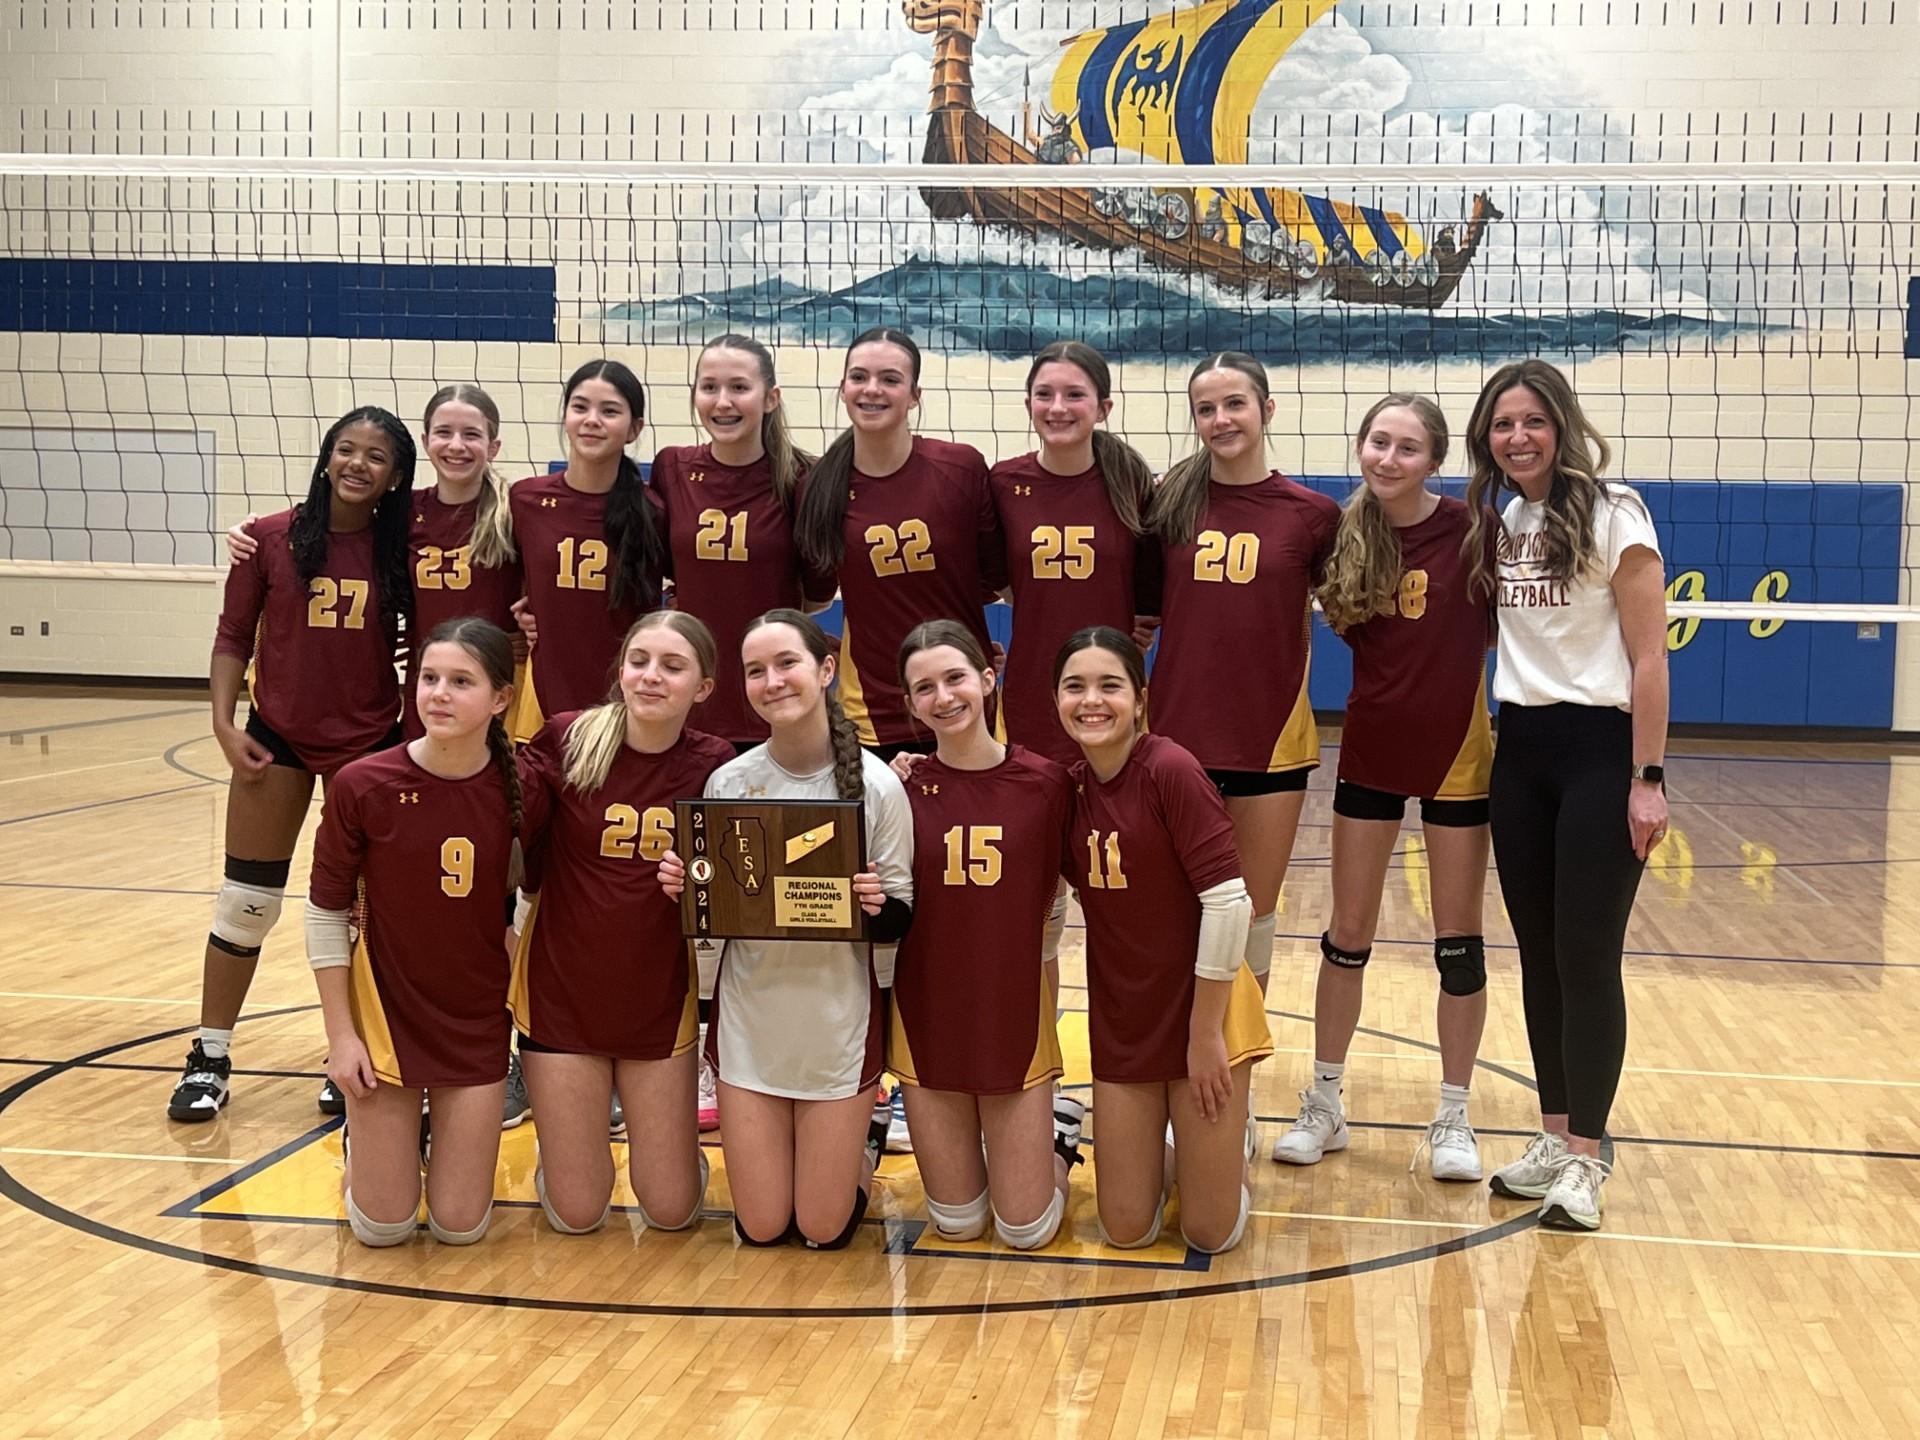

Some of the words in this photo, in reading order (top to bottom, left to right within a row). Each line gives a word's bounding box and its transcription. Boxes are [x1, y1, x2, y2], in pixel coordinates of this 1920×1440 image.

[696, 508, 748, 561] 21
[864, 518, 936, 578] 22
[1031, 525, 1095, 580] 25
[1194, 530, 1260, 584] 20
[416, 546, 471, 590] 23
[556, 537, 608, 591] 12
[307, 576, 368, 629] 27
[1376, 569, 1428, 619] 8
[1500, 582, 1571, 608] LLEYBALL
[600, 803, 675, 862] 26
[734, 820, 759, 888] IESA
[944, 825, 1002, 886] 15
[1087, 829, 1128, 889] 11
[441, 837, 475, 897] 9
[788, 881, 837, 890] REGIONAL
[784, 891, 842, 901] CHAMPIONS
